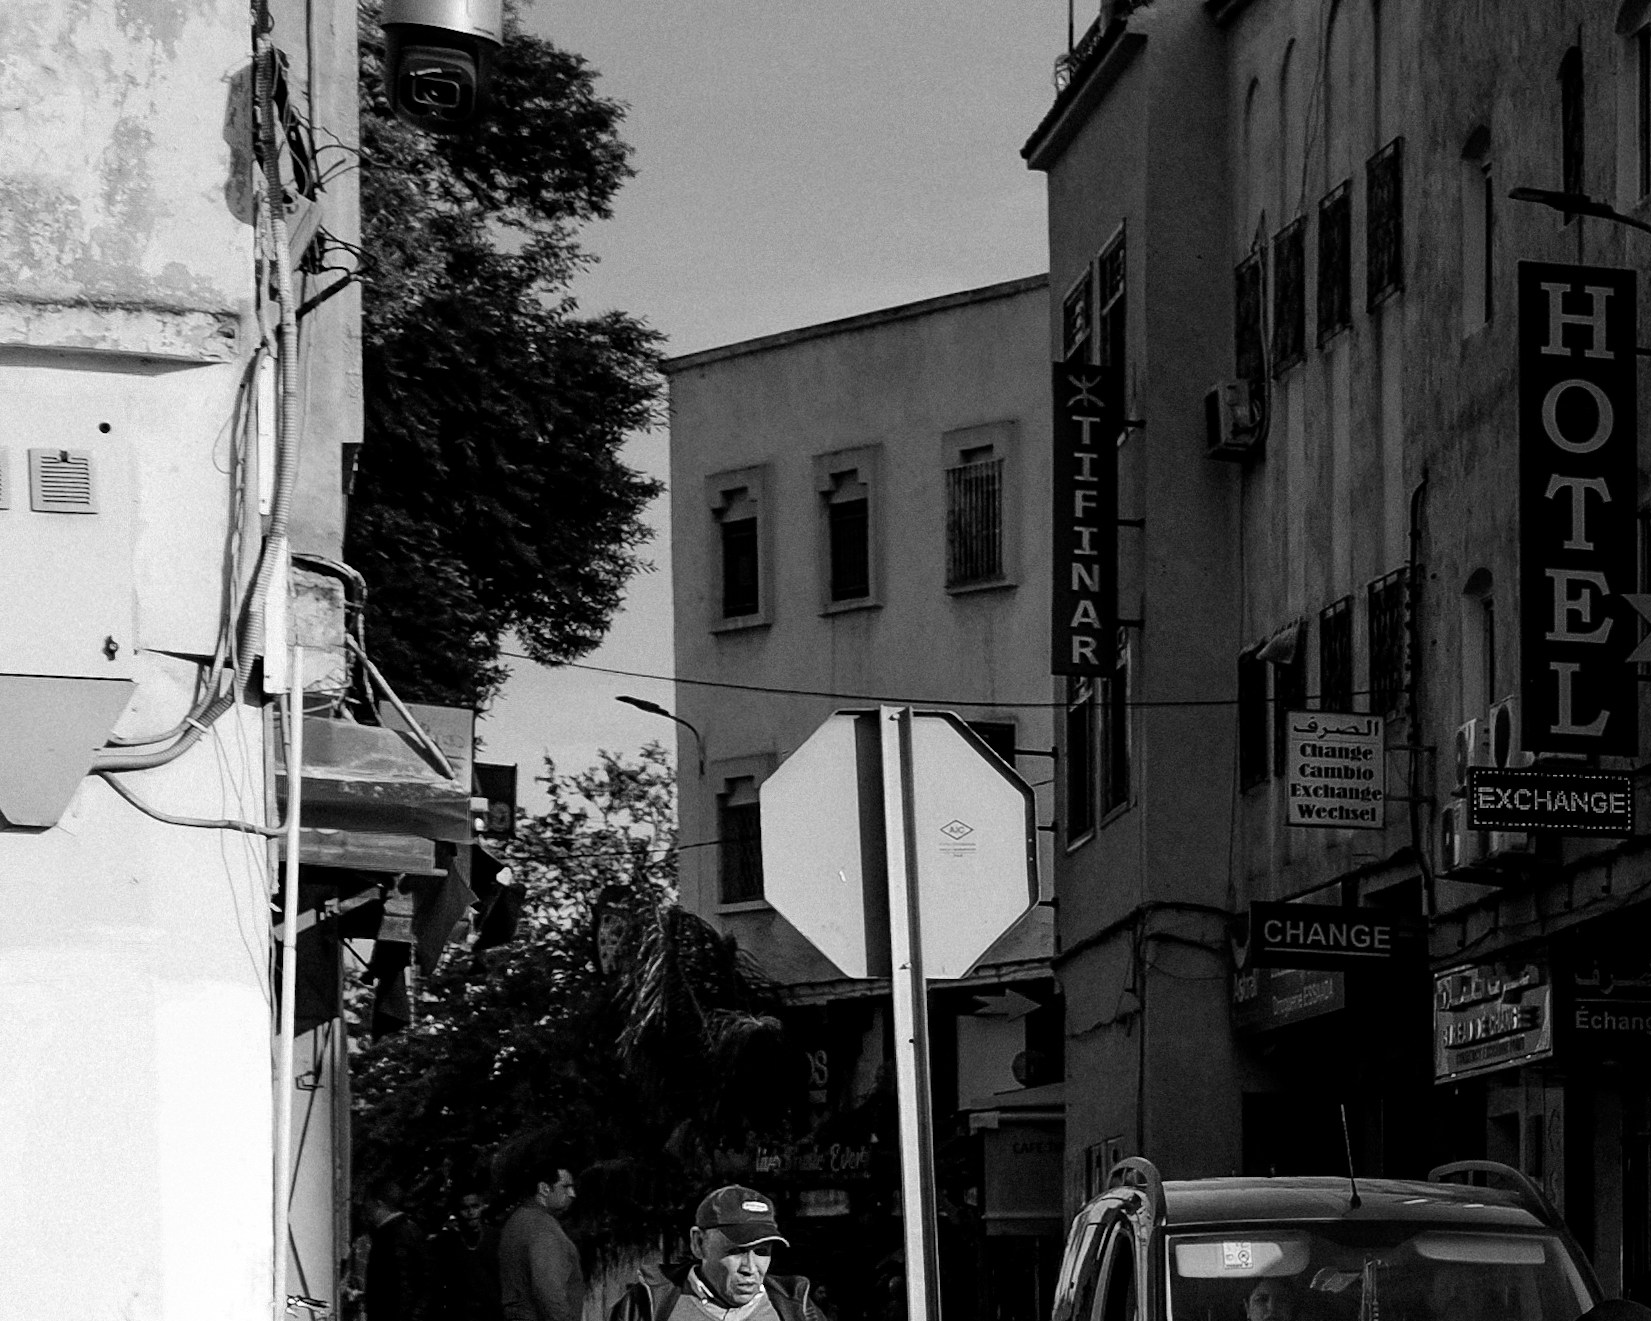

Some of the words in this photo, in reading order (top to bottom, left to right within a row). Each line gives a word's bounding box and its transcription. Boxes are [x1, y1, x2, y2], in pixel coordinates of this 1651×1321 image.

[1539, 281, 1615, 738] HOTEL
[1070, 414, 1102, 666] TIFINAR
[1293, 716, 1379, 739] الصرف
[1299, 743, 1374, 761] Change
[1299, 763, 1375, 780] Cambio
[1290, 783, 1382, 802] Exchange
[1477, 786, 1626, 814] EXCHANGE
[1297, 804, 1377, 822] Wechsel
[1264, 919, 1391, 949] CHANGE
